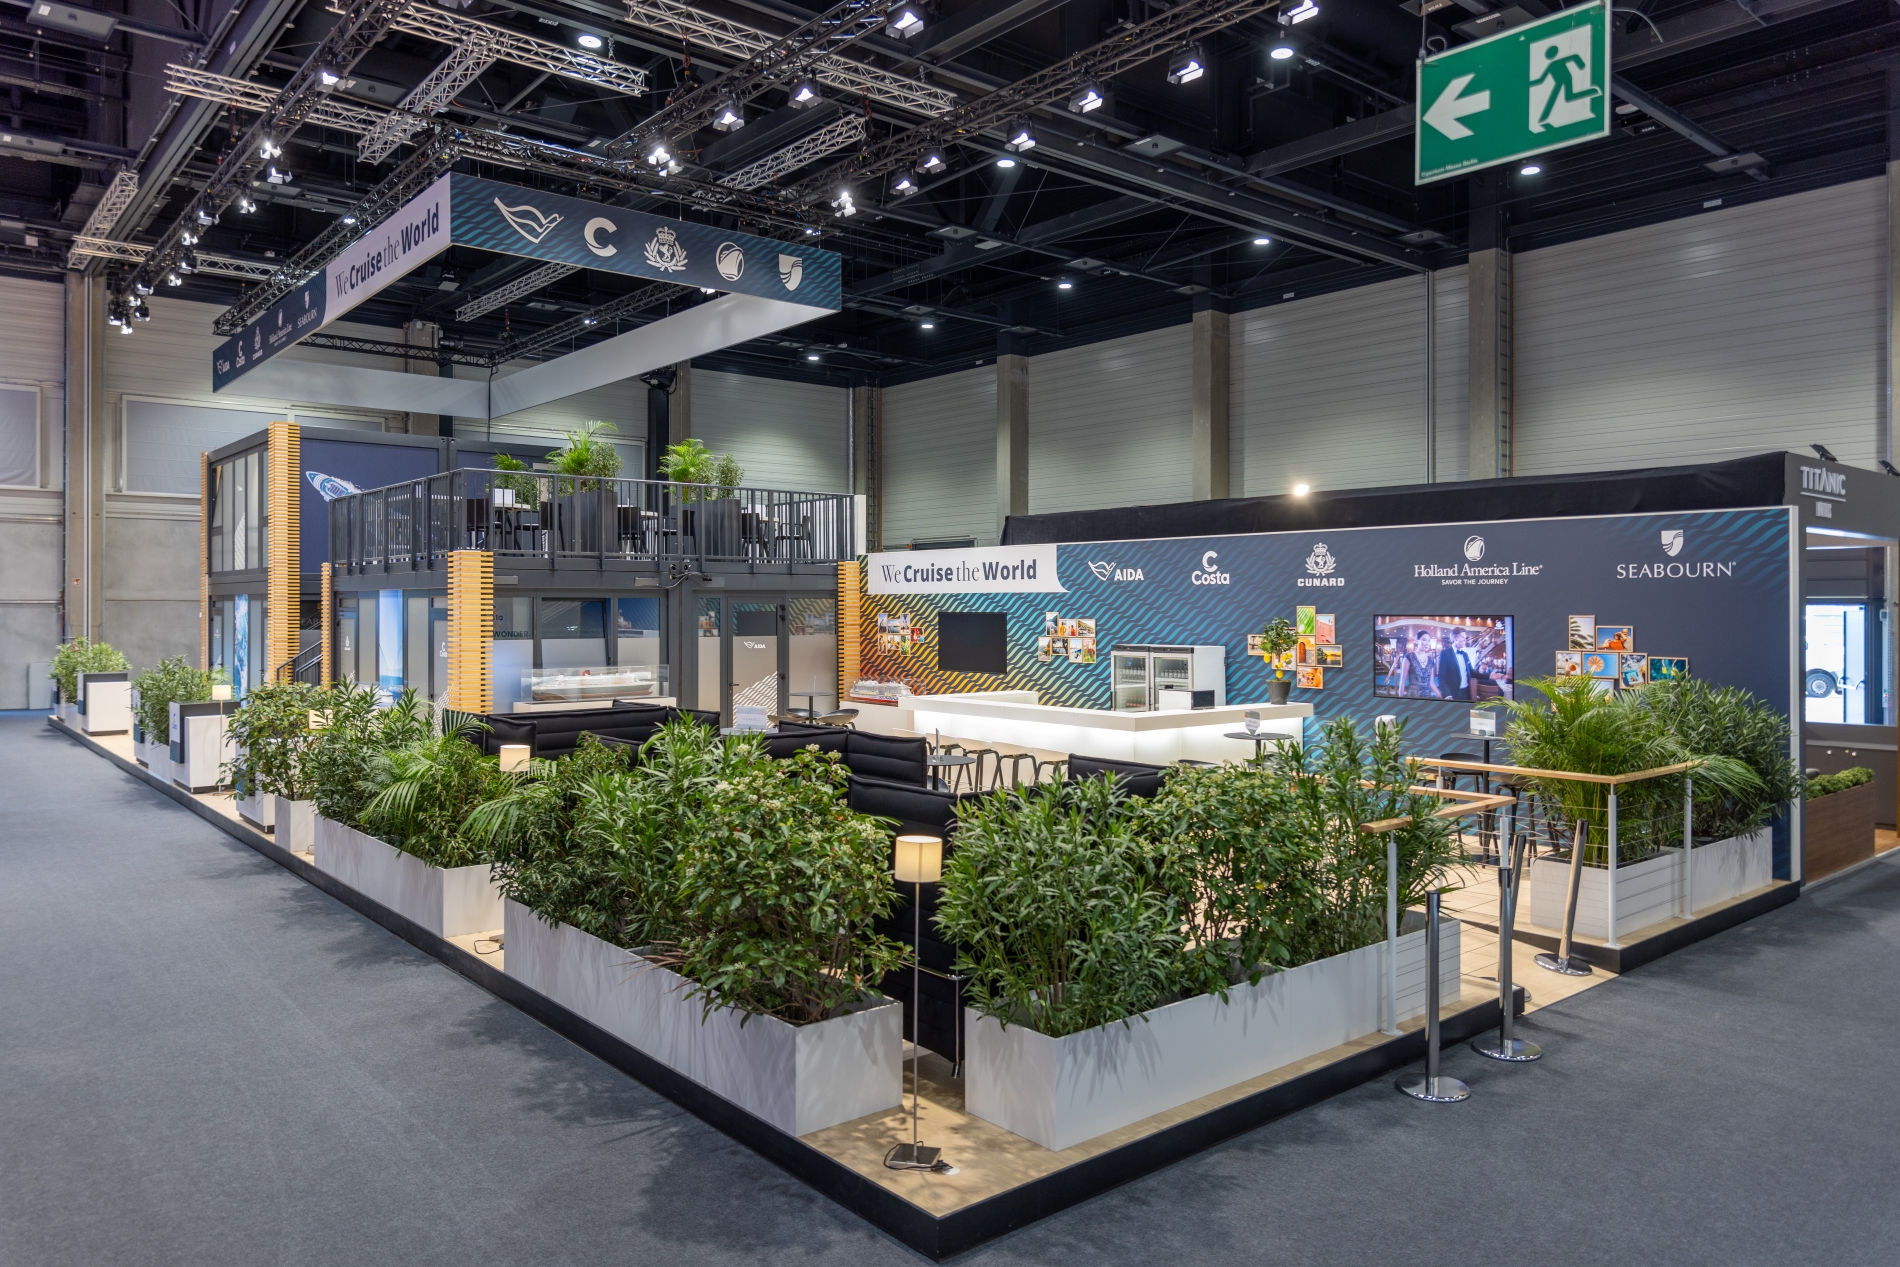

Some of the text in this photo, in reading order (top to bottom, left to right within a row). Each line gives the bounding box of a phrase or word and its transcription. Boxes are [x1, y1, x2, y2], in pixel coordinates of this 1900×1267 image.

[335, 202, 439, 299] We Cruise the World
[1800, 466, 1846, 495] TITANIC
[881, 558, 1037, 583] We Cruise the World
[1114, 568, 1145, 581] AIDA
[1191, 570, 1230, 586] Costa
[1414, 564, 1458, 578] Holland
[1460, 563, 1510, 577] America
[1297, 577, 1345, 587] CUNARD
